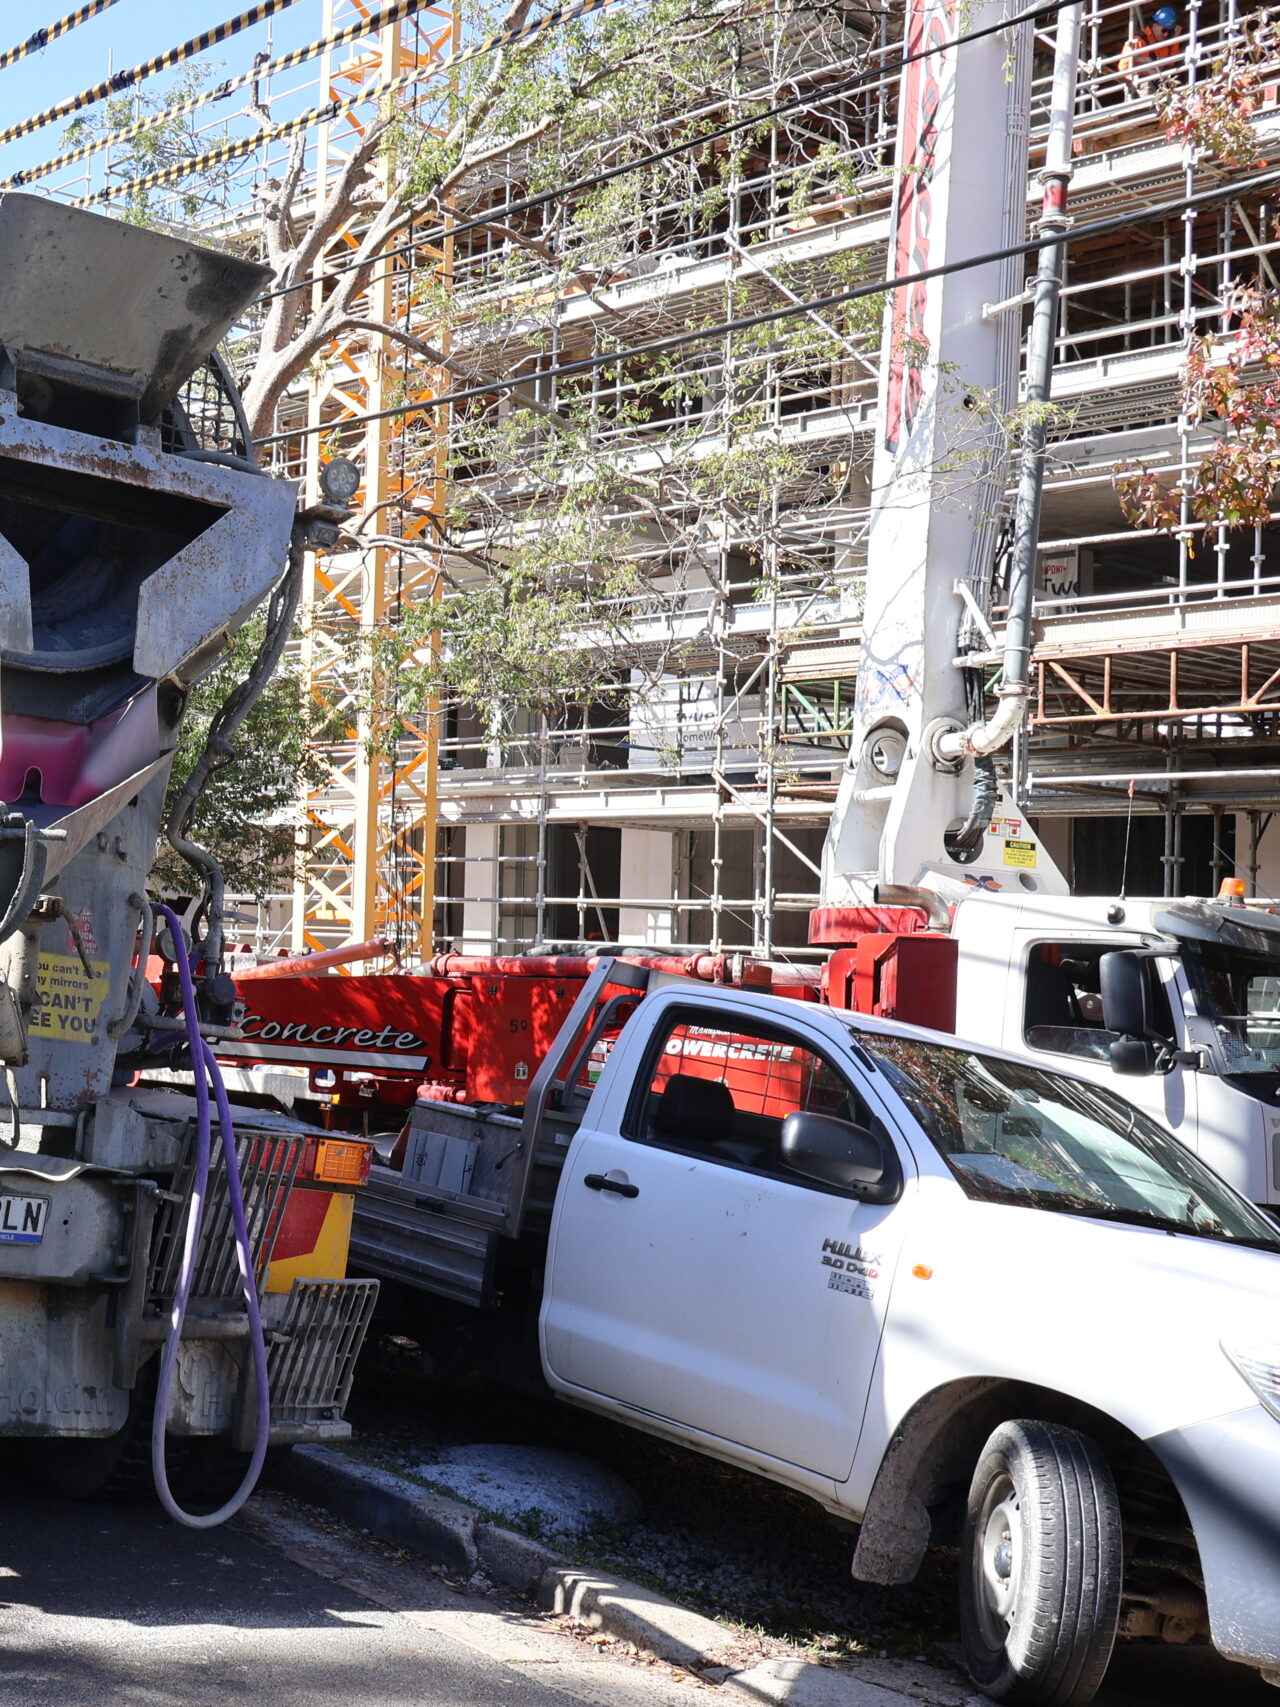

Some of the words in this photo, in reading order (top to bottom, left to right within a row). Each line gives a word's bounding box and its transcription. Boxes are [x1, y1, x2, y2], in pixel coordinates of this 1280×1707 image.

[52, 963, 79, 975] can't
[50, 976, 89, 990] mirrors
[29, 1008, 51, 1028] EE
[57, 1014, 96, 1034] YOU
[236, 1015, 423, 1050] Concrete
[665, 1038, 795, 1062] OWERCRETE
